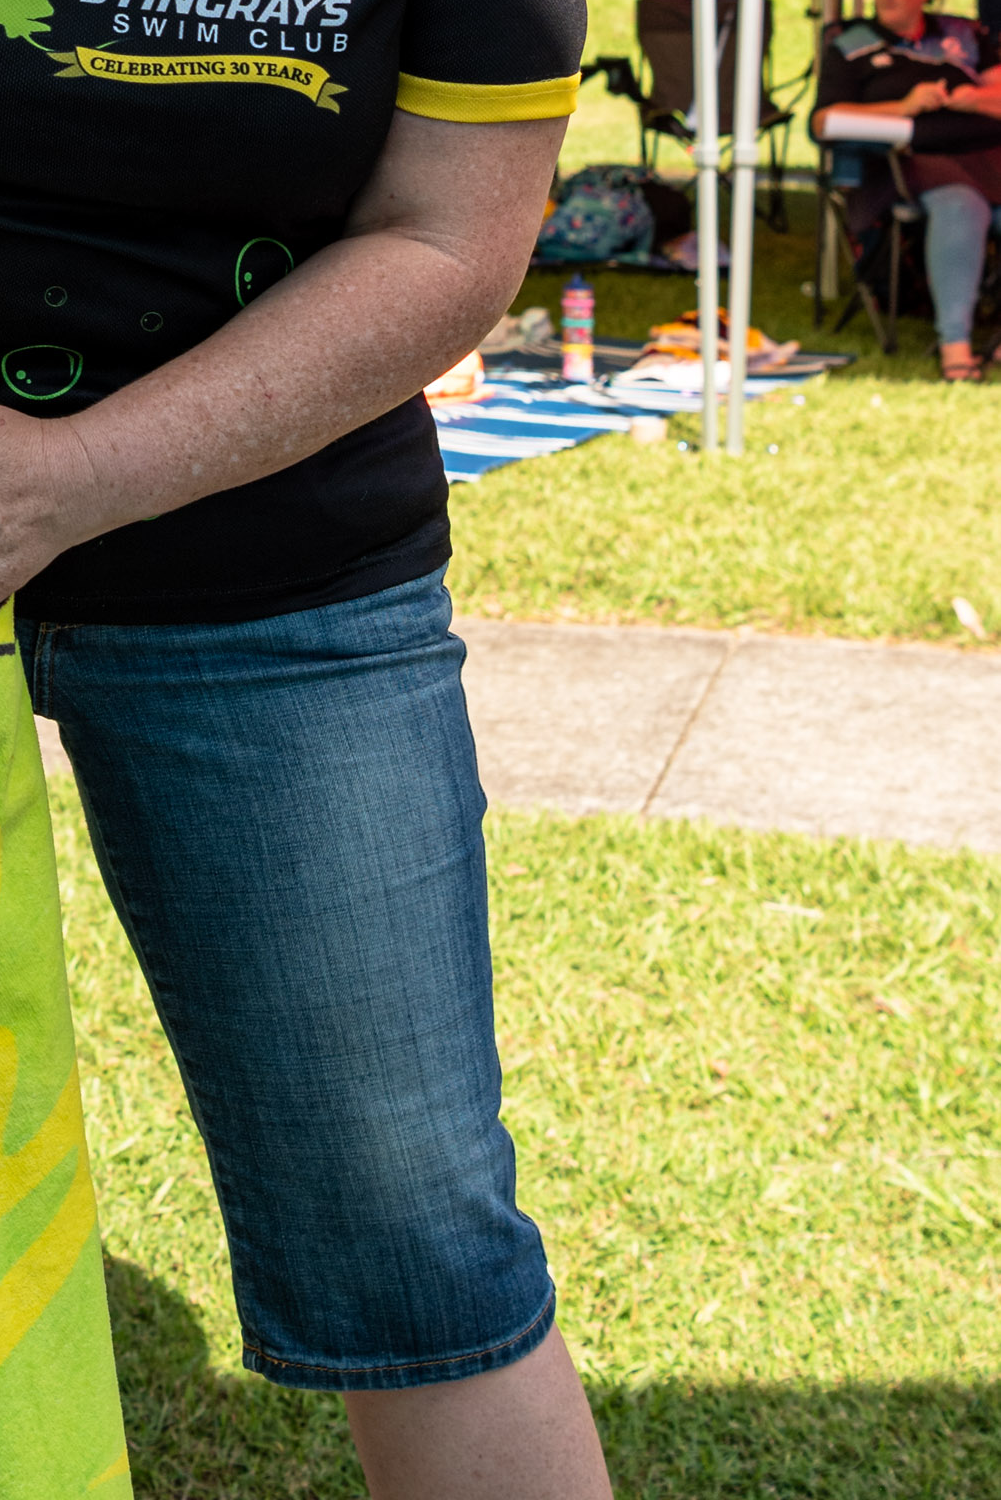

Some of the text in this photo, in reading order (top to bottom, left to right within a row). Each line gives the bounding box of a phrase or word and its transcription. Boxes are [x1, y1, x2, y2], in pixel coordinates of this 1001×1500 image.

[112, 12, 349, 53] SWIM CLUB
[90, 56, 313, 86] CELEBRATING 30 YEARS
